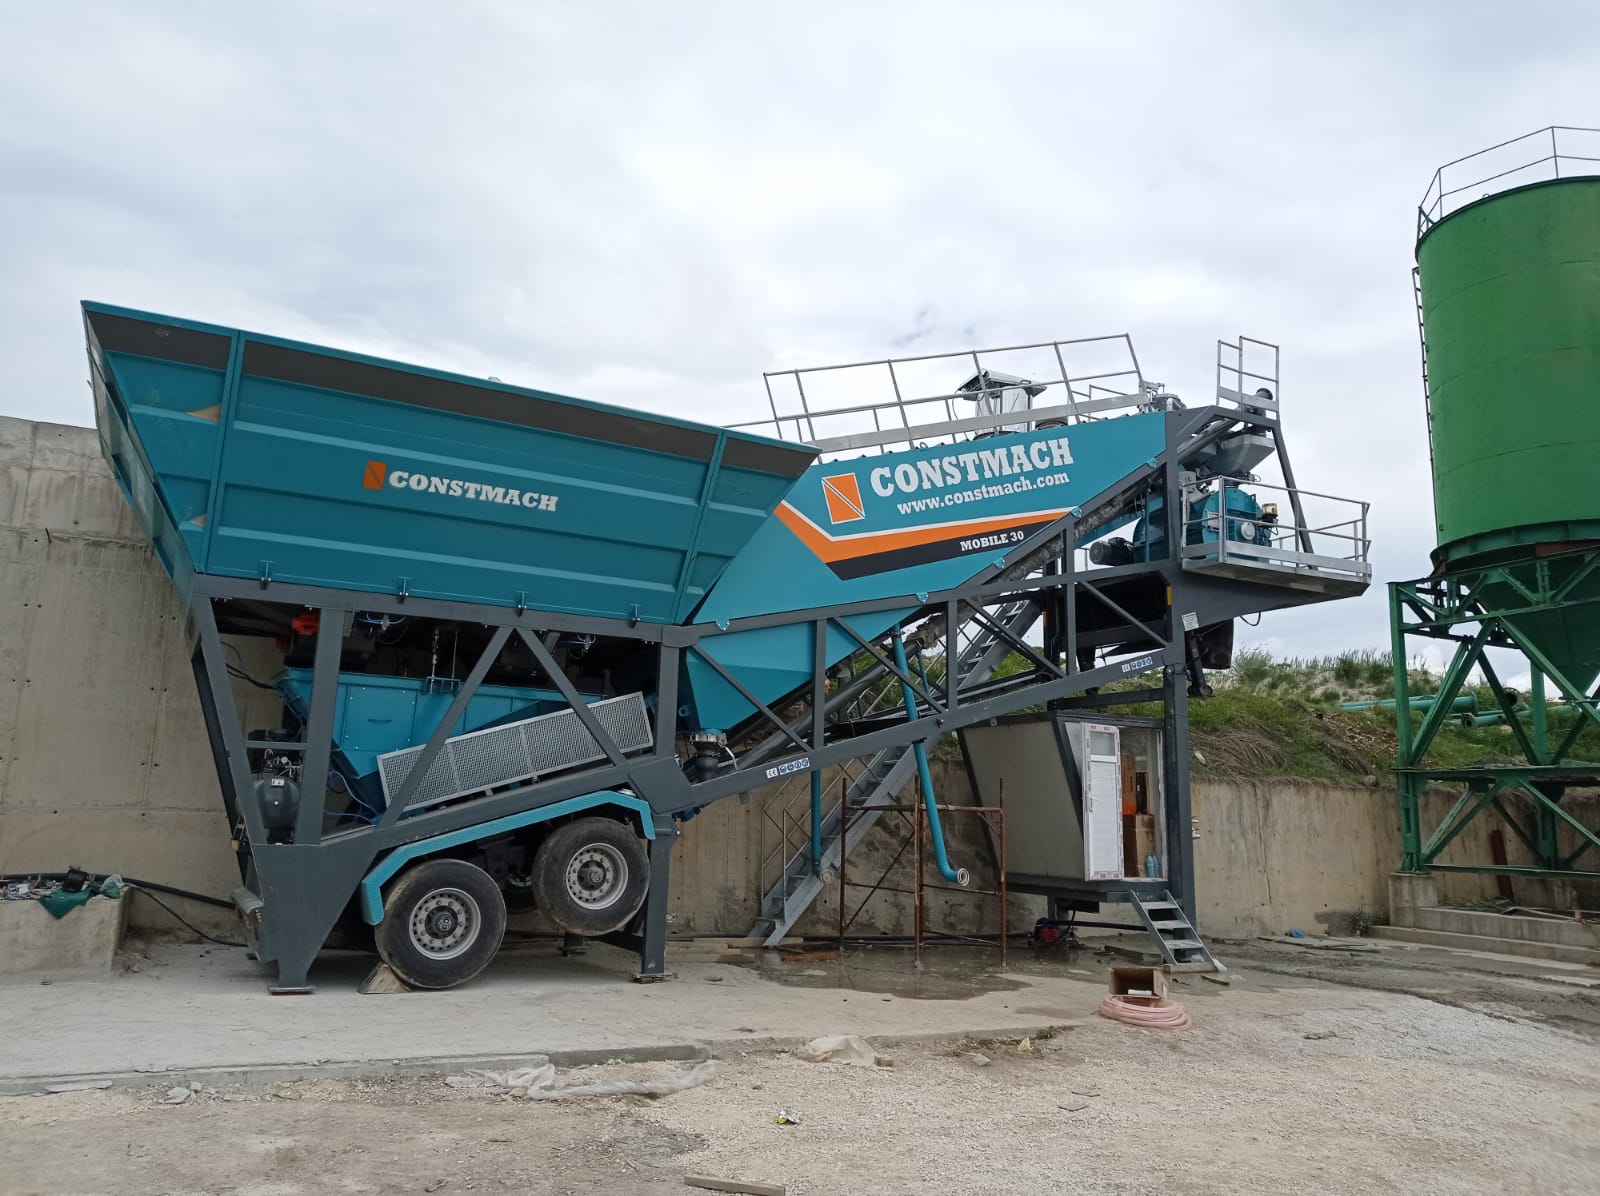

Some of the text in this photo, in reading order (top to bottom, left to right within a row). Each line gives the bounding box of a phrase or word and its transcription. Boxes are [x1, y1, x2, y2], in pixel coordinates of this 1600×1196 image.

[871, 438, 1074, 497] CONSTMACH
[389, 471, 558, 511] CONSTMACH
[897, 471, 1070, 515] www.constmach.com
[959, 530, 1025, 552] MOBILE 30
